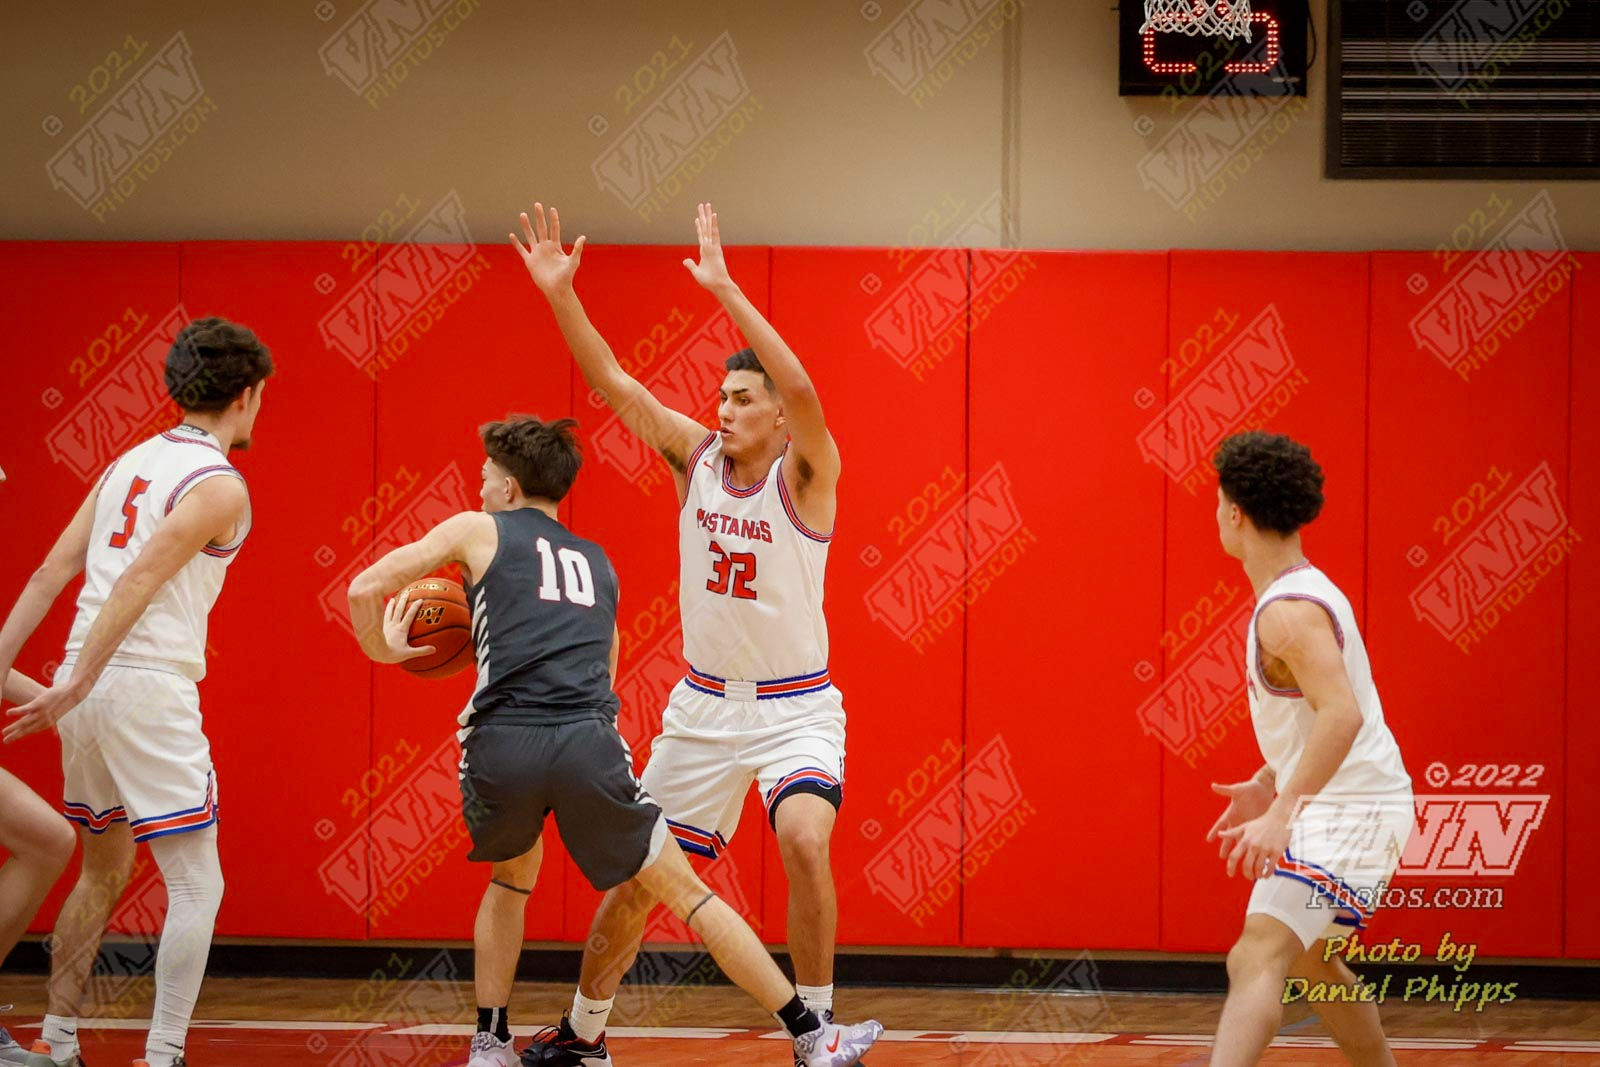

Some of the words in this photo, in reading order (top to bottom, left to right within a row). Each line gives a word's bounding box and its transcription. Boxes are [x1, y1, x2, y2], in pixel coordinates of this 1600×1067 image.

[108, 475, 152, 549] 5
[536, 537, 596, 607] 10
[706, 540, 757, 600] 32
